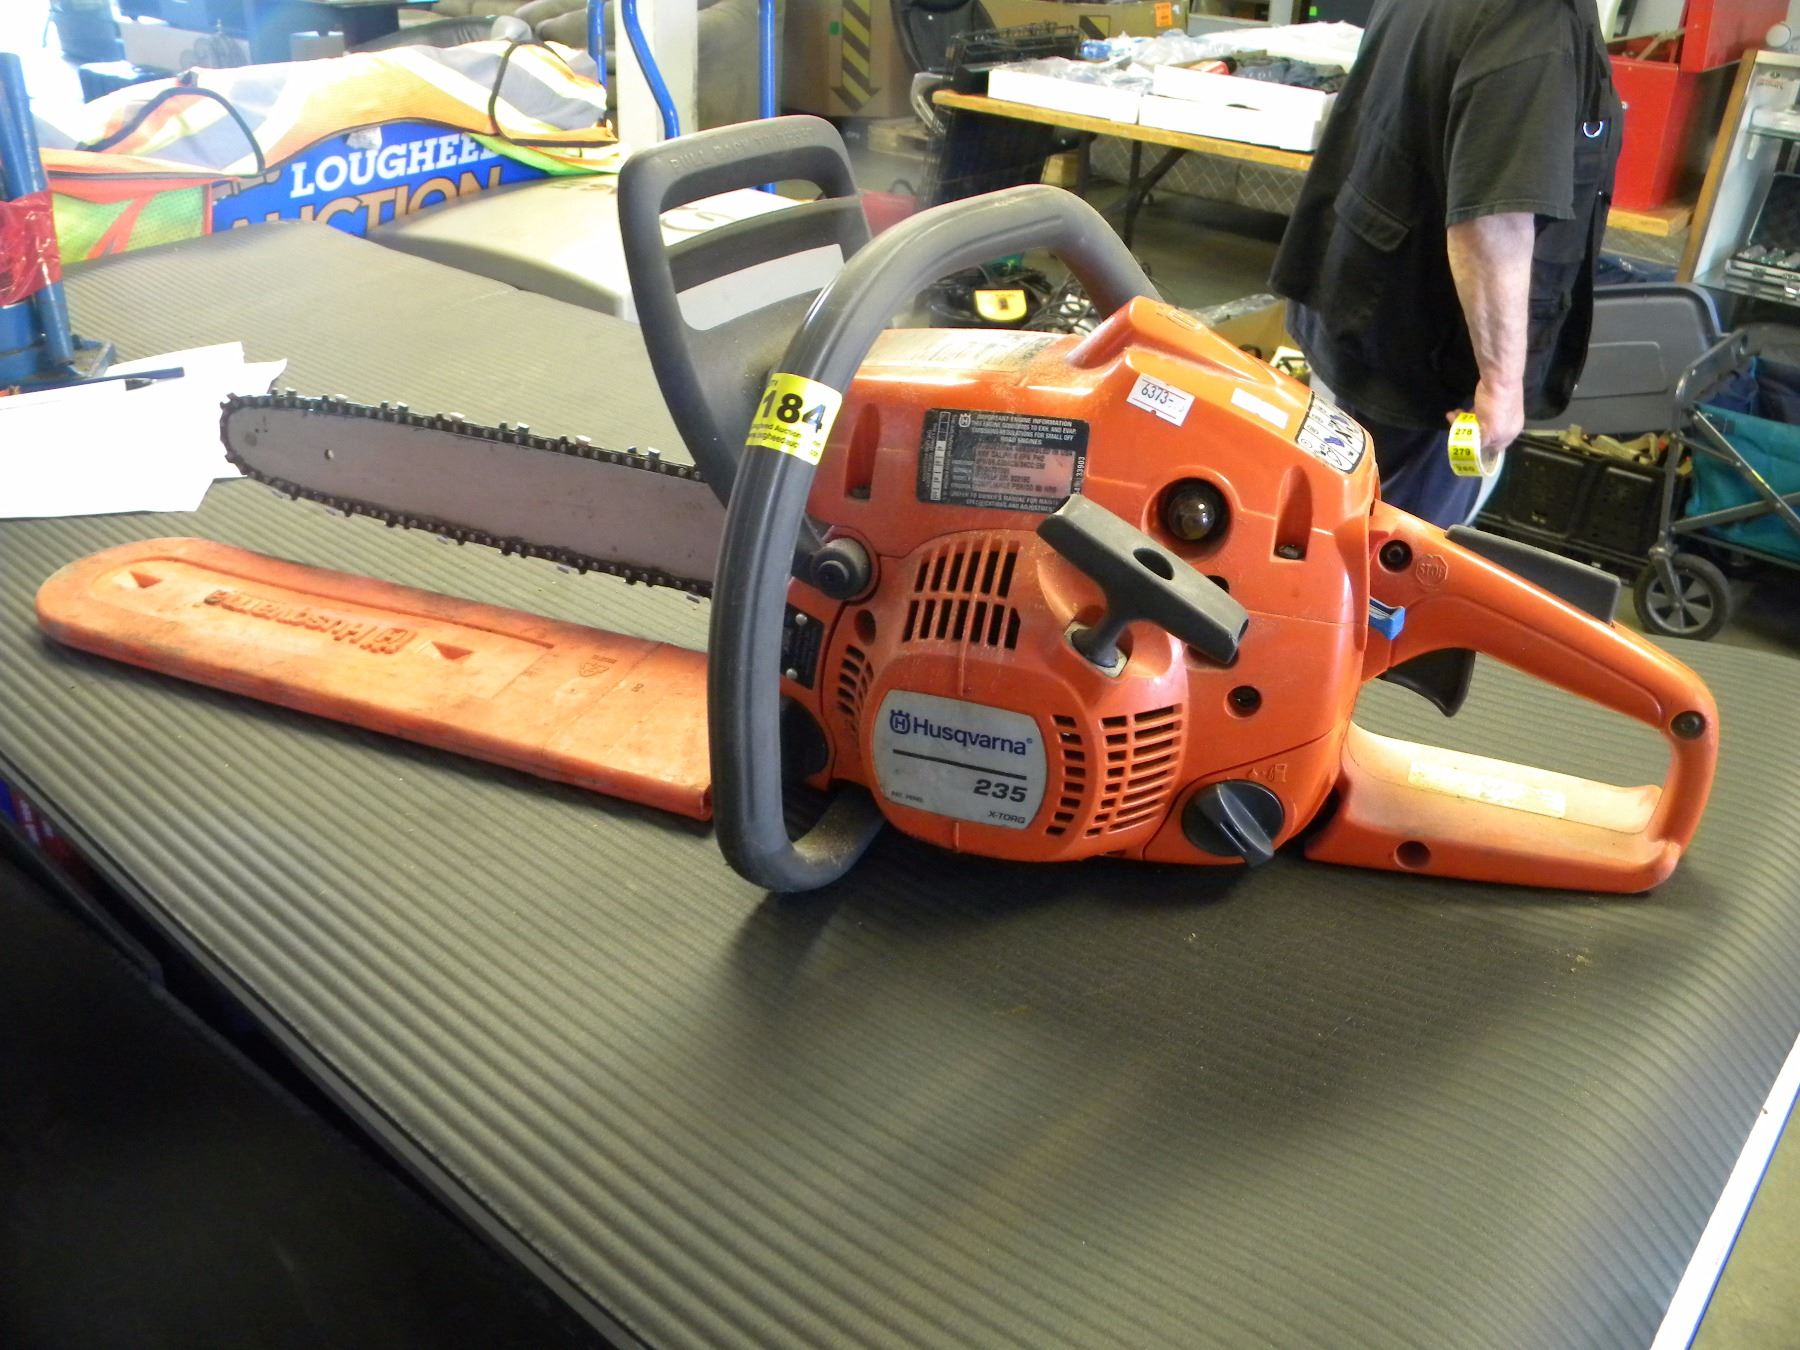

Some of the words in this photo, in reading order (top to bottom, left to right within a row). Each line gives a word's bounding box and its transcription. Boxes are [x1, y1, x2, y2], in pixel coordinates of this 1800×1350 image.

[231, 166, 502, 237] CTION
[762, 390, 827, 433] 184
[1033, 417, 1072, 427] INFORMATION
[1045, 432, 1063, 440] SMALL
[1454, 428, 1473, 436] 278
[1452, 447, 1471, 456] 279
[1419, 562, 1446, 578] STOP
[913, 717, 1026, 756] Husqvarna
[974, 779, 1027, 802] 235
[987, 810, 1026, 824] X-TORQ
